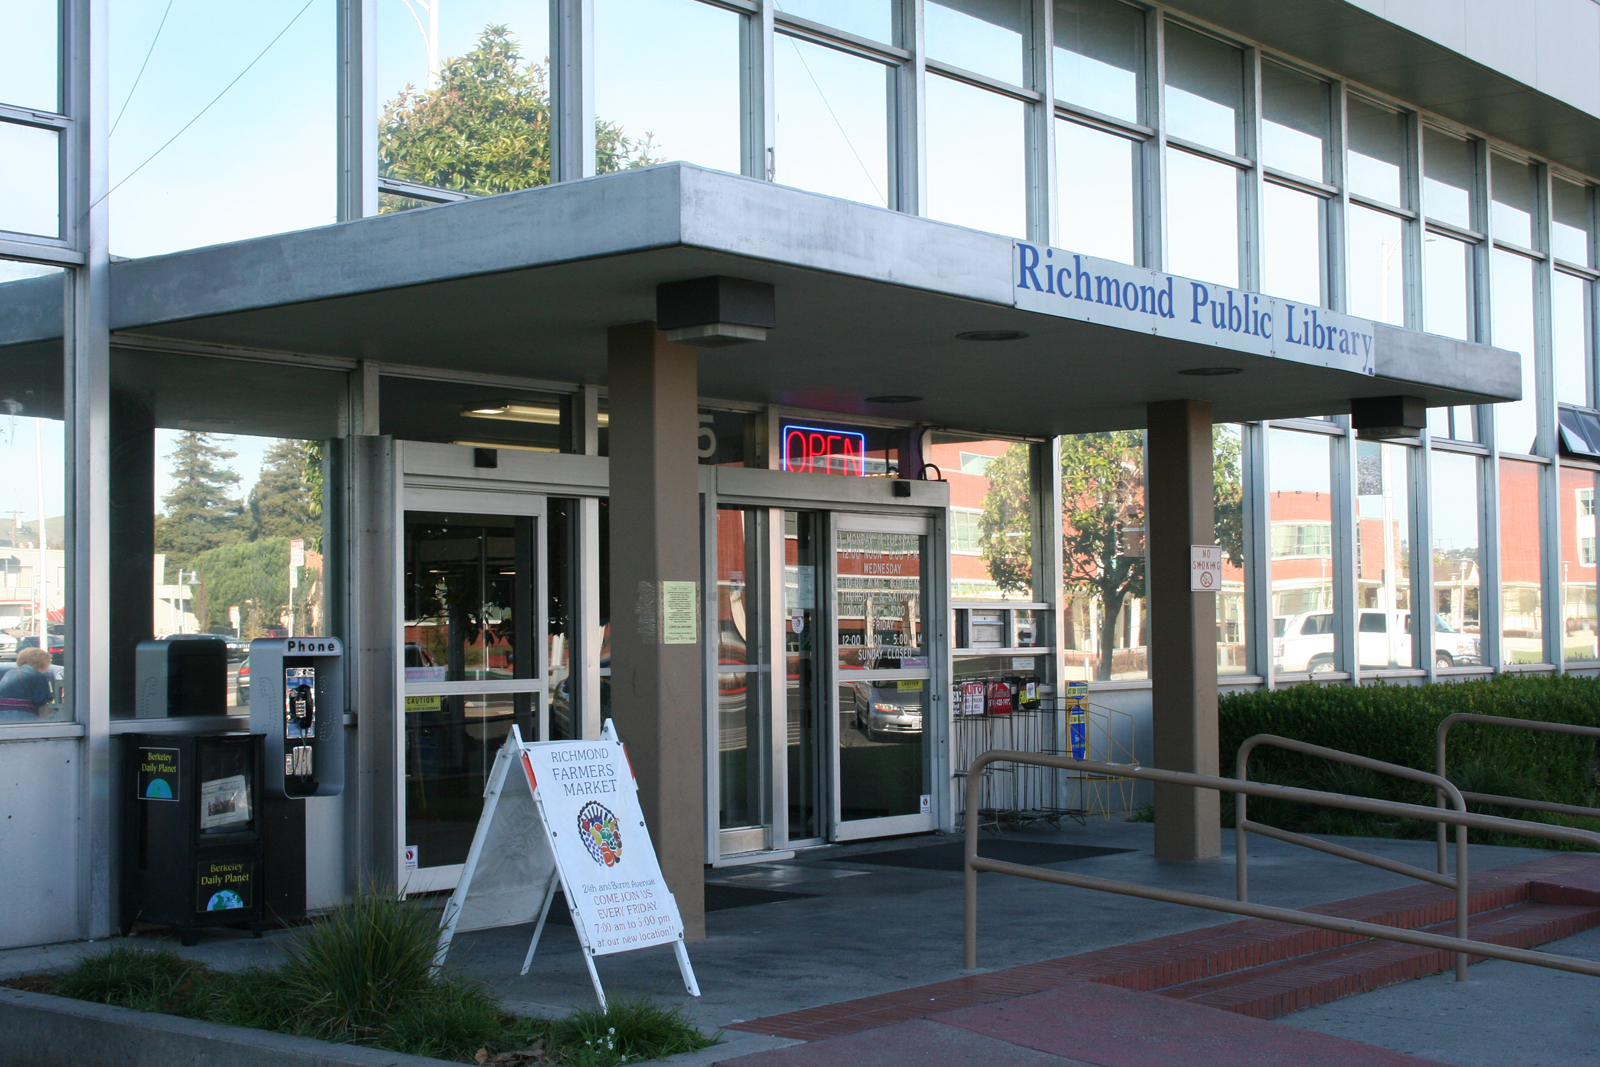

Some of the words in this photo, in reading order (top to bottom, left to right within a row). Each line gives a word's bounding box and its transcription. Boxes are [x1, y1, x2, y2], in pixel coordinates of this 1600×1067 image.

[1016, 243, 1174, 319] Richmond
[1190, 281, 1272, 339] Public
[1286, 304, 1373, 375] Library
[786, 431, 863, 477] OPEN
[846, 533, 872, 545] MONDAY
[886, 534, 914, 546] TUESDAY
[1202, 549, 1211, 558] NO
[863, 563, 902, 574] WEDNESDAY
[1192, 560, 1221, 571] SMOKING
[841, 591, 874, 602] THURSDAY
[889, 592, 920, 603] SATURDAY
[872, 620, 894, 631] FRIDAY
[287, 640, 335, 652] Phone
[842, 634, 861, 646] 12:00
[864, 634, 883, 646] NOON
[893, 634, 908, 645] 5:00
[858, 649, 883, 660] SUNDAY
[887, 648, 912, 660] CLOSED
[406, 697, 435, 705] CAUTION
[147, 752, 173, 763] Berkeley
[550, 747, 609, 763] RICHMOND
[141, 763, 157, 775] Daily
[158, 763, 177, 773] Planet
[552, 763, 614, 780] FARMERS
[563, 779, 617, 796] MARKET
[210, 863, 244, 873] Berkeley
[201, 874, 223, 886] Daily
[224, 873, 250, 883] Planet
[598, 883, 611, 892] and
[631, 878, 656, 888] Avenue
[593, 892, 620, 906] COME
[620, 890, 640, 903] JOIN
[641, 888, 653, 899] US
[597, 906, 625, 919] EVERY
[626, 901, 658, 915] FRIDAY
[594, 922, 612, 933] 7:00
[614, 922, 626, 931] am
[627, 919, 637, 929] to
[637, 915, 656, 928] 5:00
[657, 914, 671, 926] pm
[597, 938, 606, 948] at
[607, 938, 620, 947] our
[622, 935, 638, 944] new
[639, 925, 676, 941] location!!
